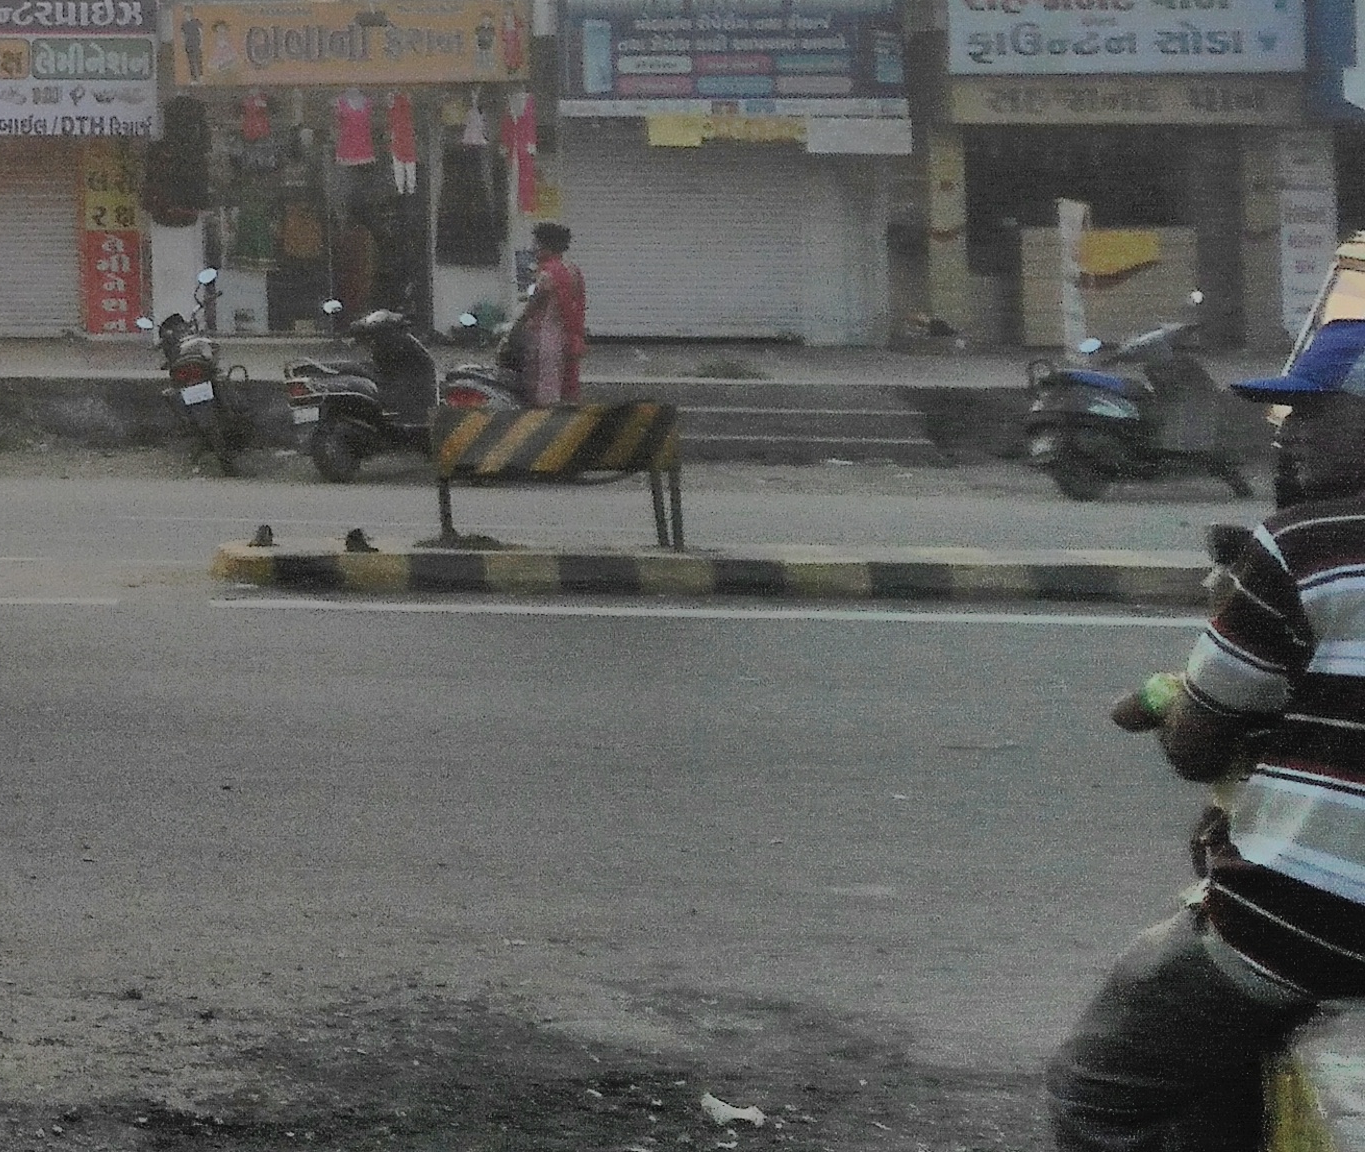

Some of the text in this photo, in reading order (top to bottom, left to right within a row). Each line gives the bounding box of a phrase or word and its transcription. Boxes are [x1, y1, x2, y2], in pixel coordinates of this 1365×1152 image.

[1155, 19, 1244, 56] સોડા
[34, 42, 149, 75] લેમીનેશન
[61, 115, 105, 135] DTH
